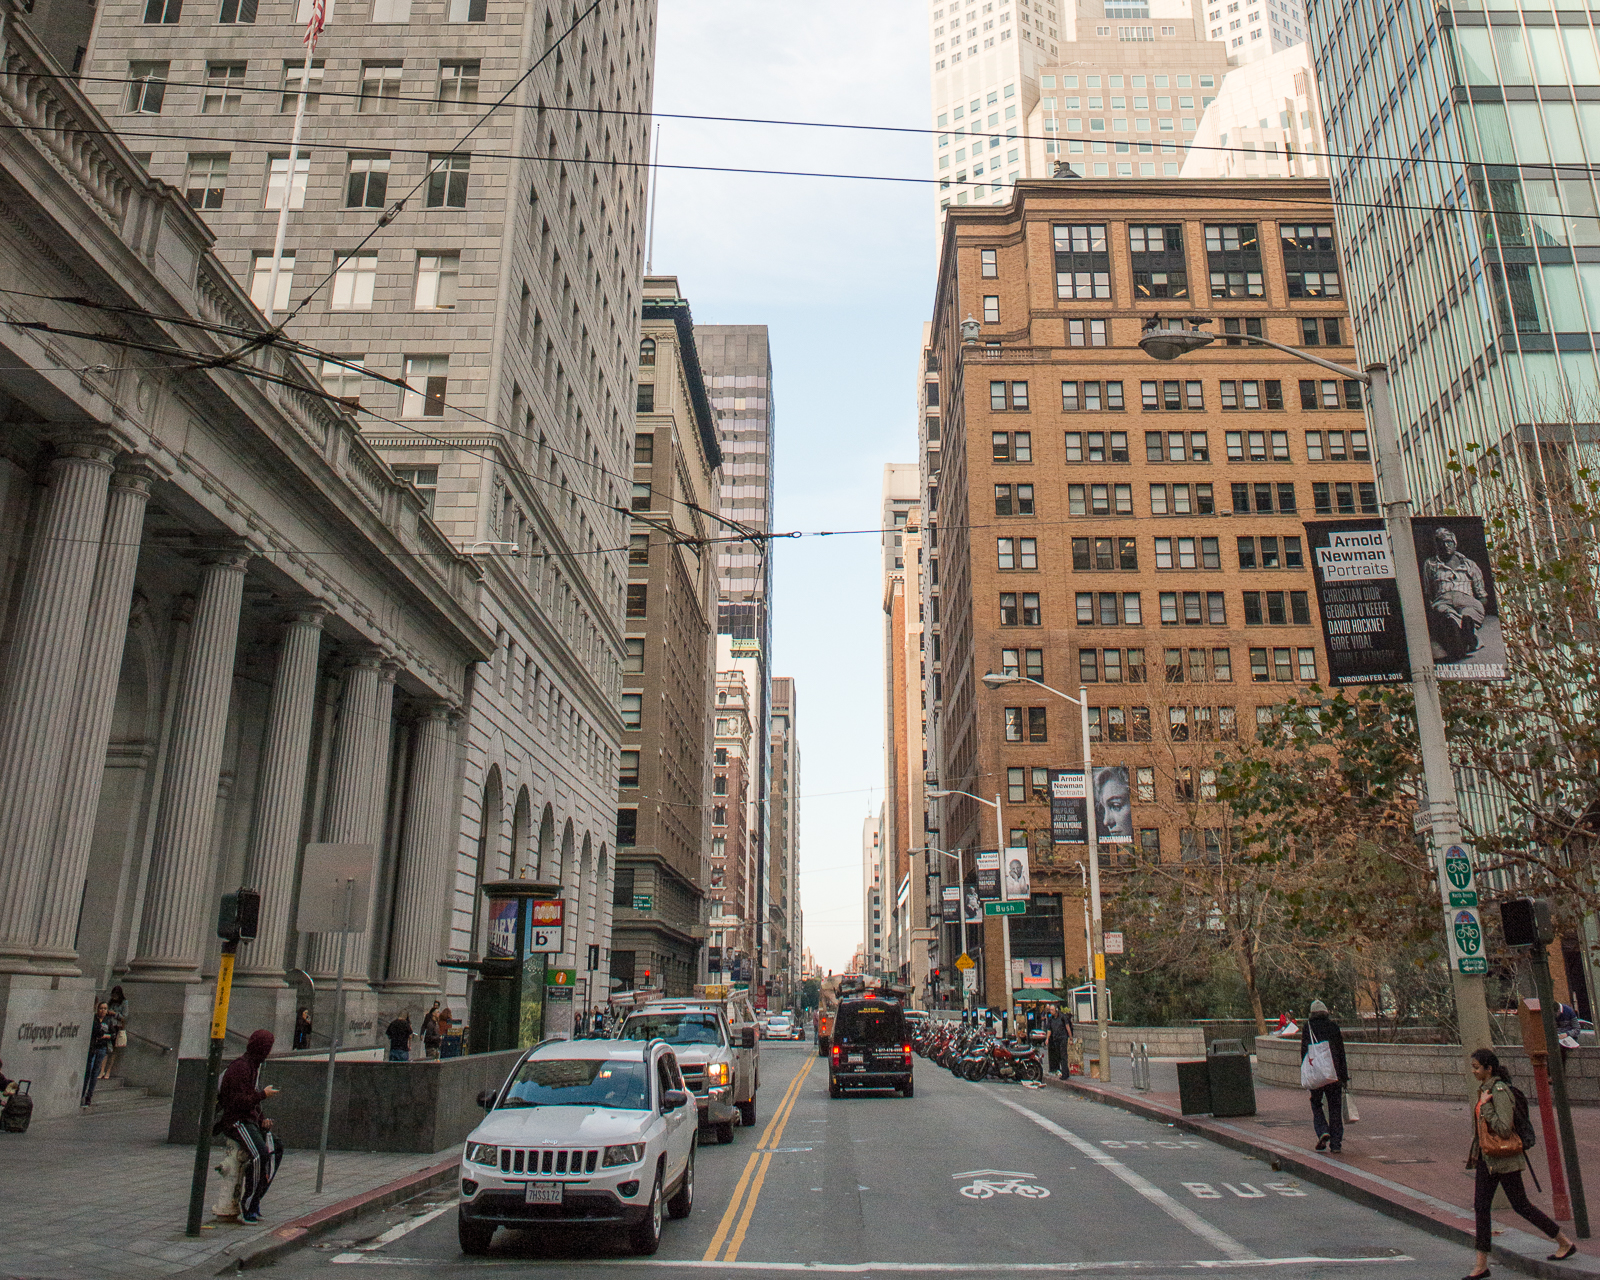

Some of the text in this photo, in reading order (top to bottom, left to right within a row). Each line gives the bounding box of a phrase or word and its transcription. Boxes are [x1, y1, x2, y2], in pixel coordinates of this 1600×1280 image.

[1334, 534, 1383, 547] Arnold
[1320, 550, 1386, 562] Newman
[1328, 563, 1389, 576] Portraits
[1322, 586, 1381, 603] CHRISTIAN DIOR
[1326, 602, 1391, 618] GEORGIA O'KEEFFE
[1328, 618, 1386, 634] DAVID HOCKNEY
[1330, 635, 1374, 650] GORE VIDAL
[1338, 675, 1369, 683] THROUGH
[1370, 674, 1382, 682] FEB
[1388, 672, 1403, 680] 2015
[1454, 873, 1465, 886] 11
[1462, 939, 1477, 952] 16
[18, 1022, 80, 1043] Citigroup Center
[529, 1190, 560, 1200] 7HSS172
[1181, 1182, 1308, 1199] BUS
